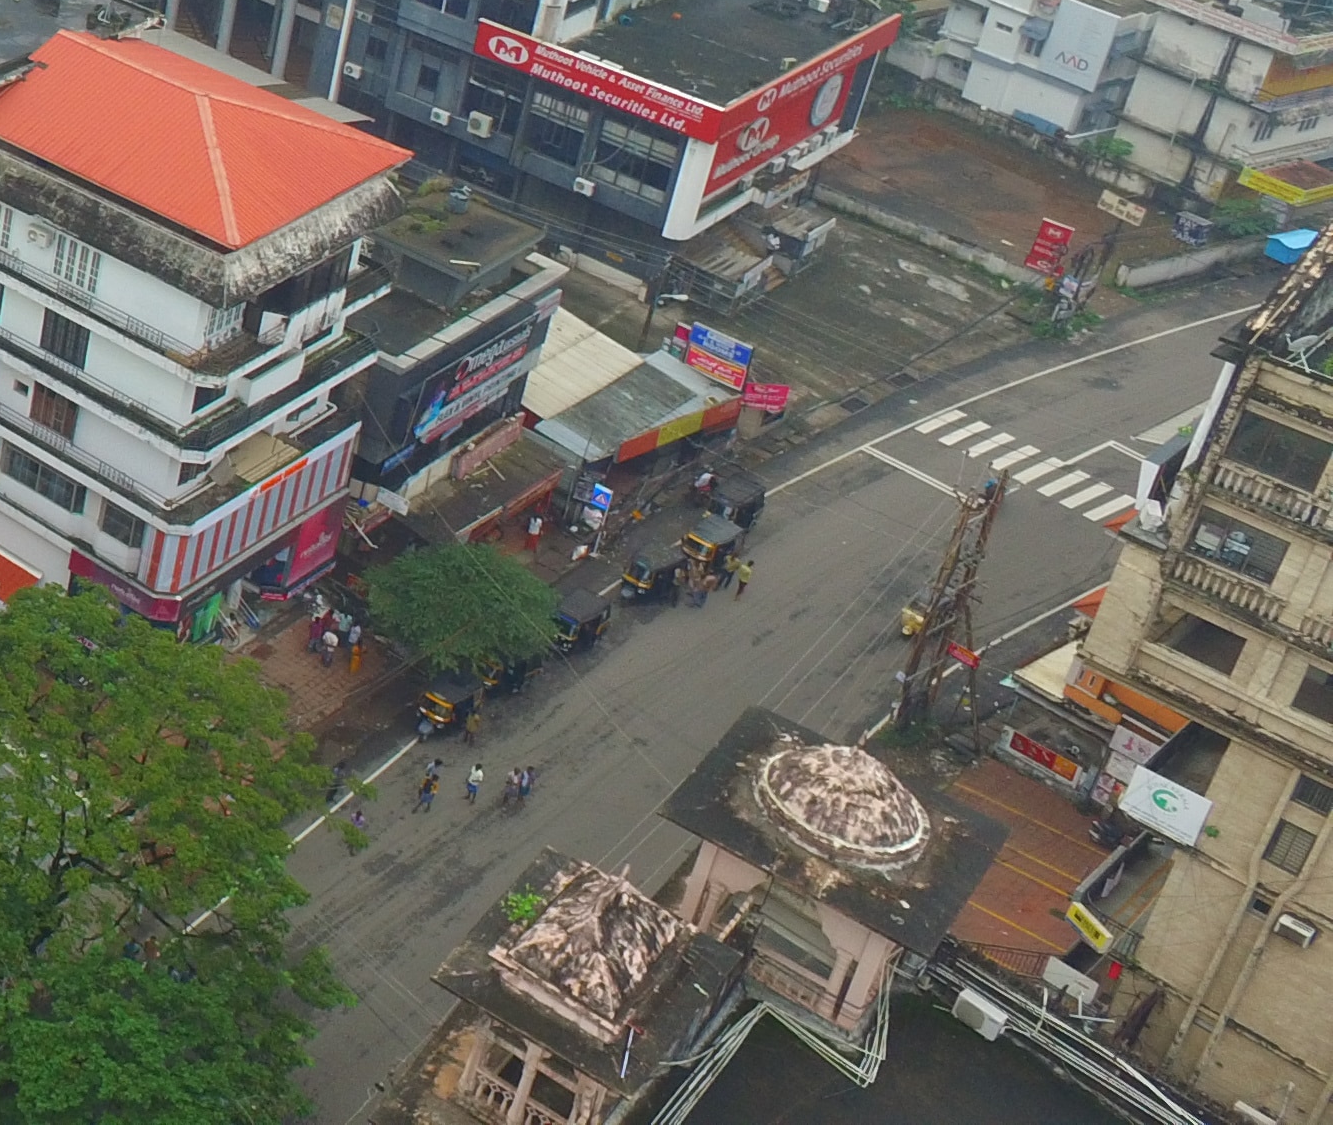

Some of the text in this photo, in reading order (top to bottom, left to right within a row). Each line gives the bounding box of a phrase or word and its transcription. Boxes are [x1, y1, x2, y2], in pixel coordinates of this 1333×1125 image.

[530, 62, 686, 133] Muthoot Securities Ltd.
[534, 45, 573, 67] Muthoot
[575, 60, 608, 80] Vehicle
[617, 77, 645, 94] Asset
[645, 86, 683, 109] Finance
[684, 102, 704, 117] Ltd.
